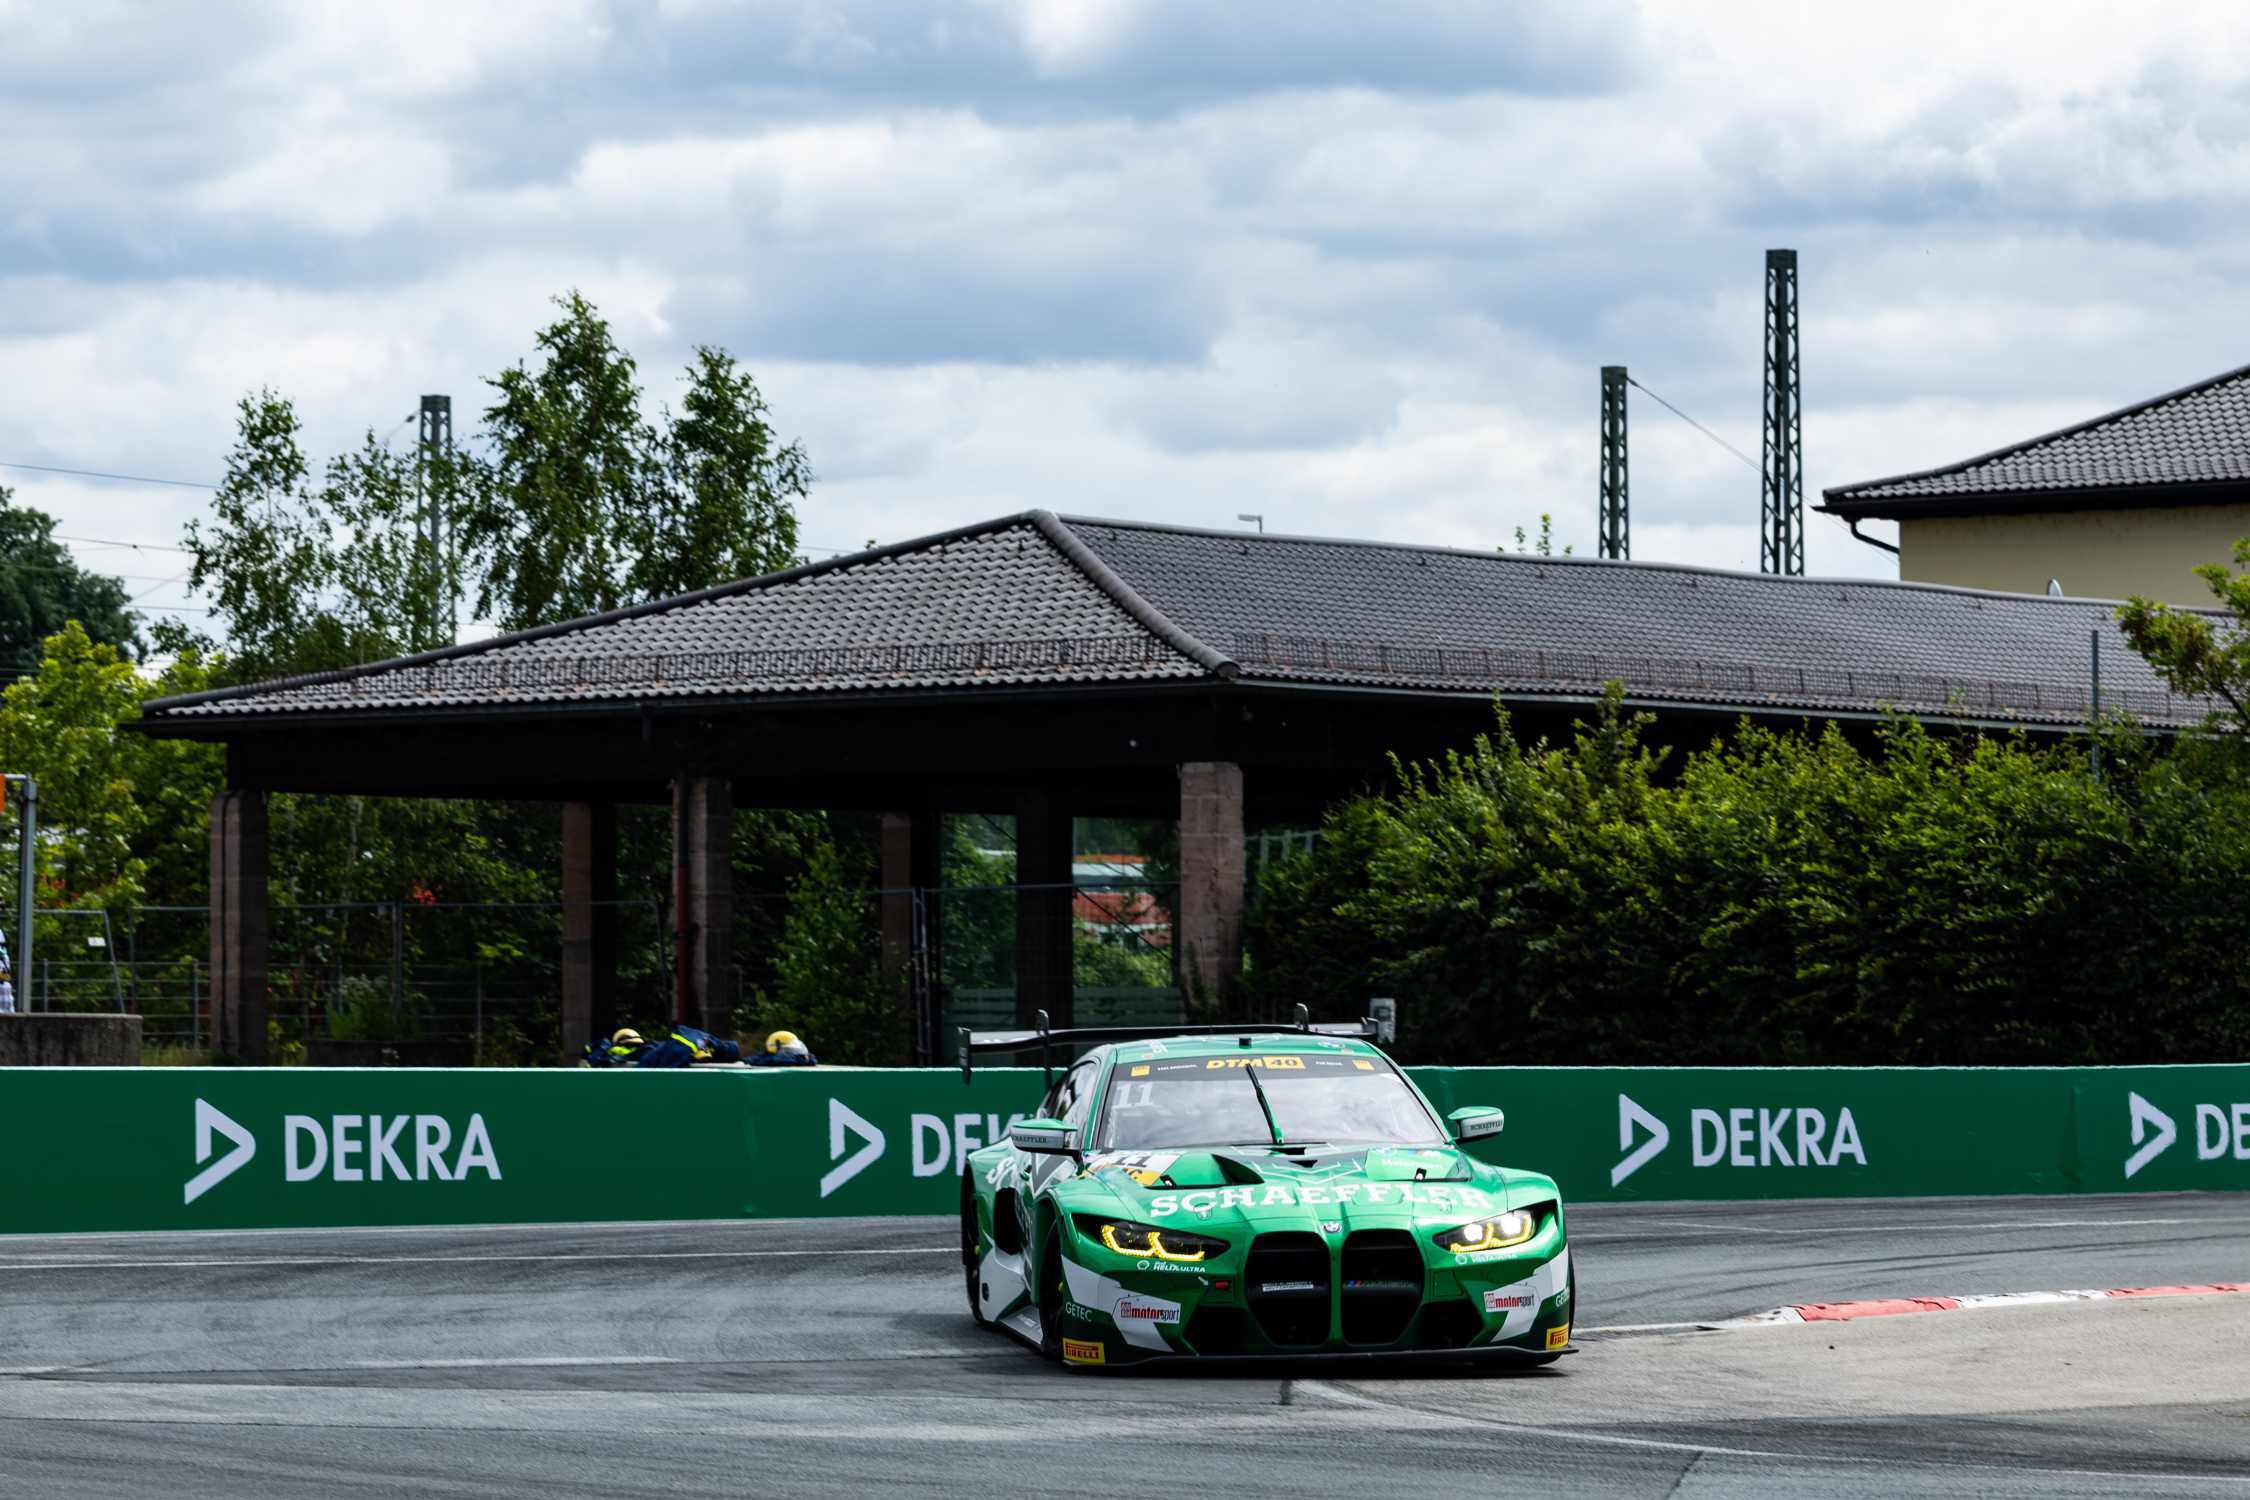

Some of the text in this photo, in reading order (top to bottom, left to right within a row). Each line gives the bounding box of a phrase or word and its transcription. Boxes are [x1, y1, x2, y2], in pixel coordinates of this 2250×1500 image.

[1206, 1059, 1263, 1070] DTM
[1270, 1057, 1300, 1067] 40
[1114, 1082, 1153, 1109] 11
[286, 1114, 502, 1182] DEKRA
[1691, 1107, 1867, 1167] DEKRA
[1150, 1182, 1490, 1219] SCHAEFFLER
[1065, 1301, 1093, 1322] GETEC
[1065, 1342, 1099, 1360] PIRELLI
